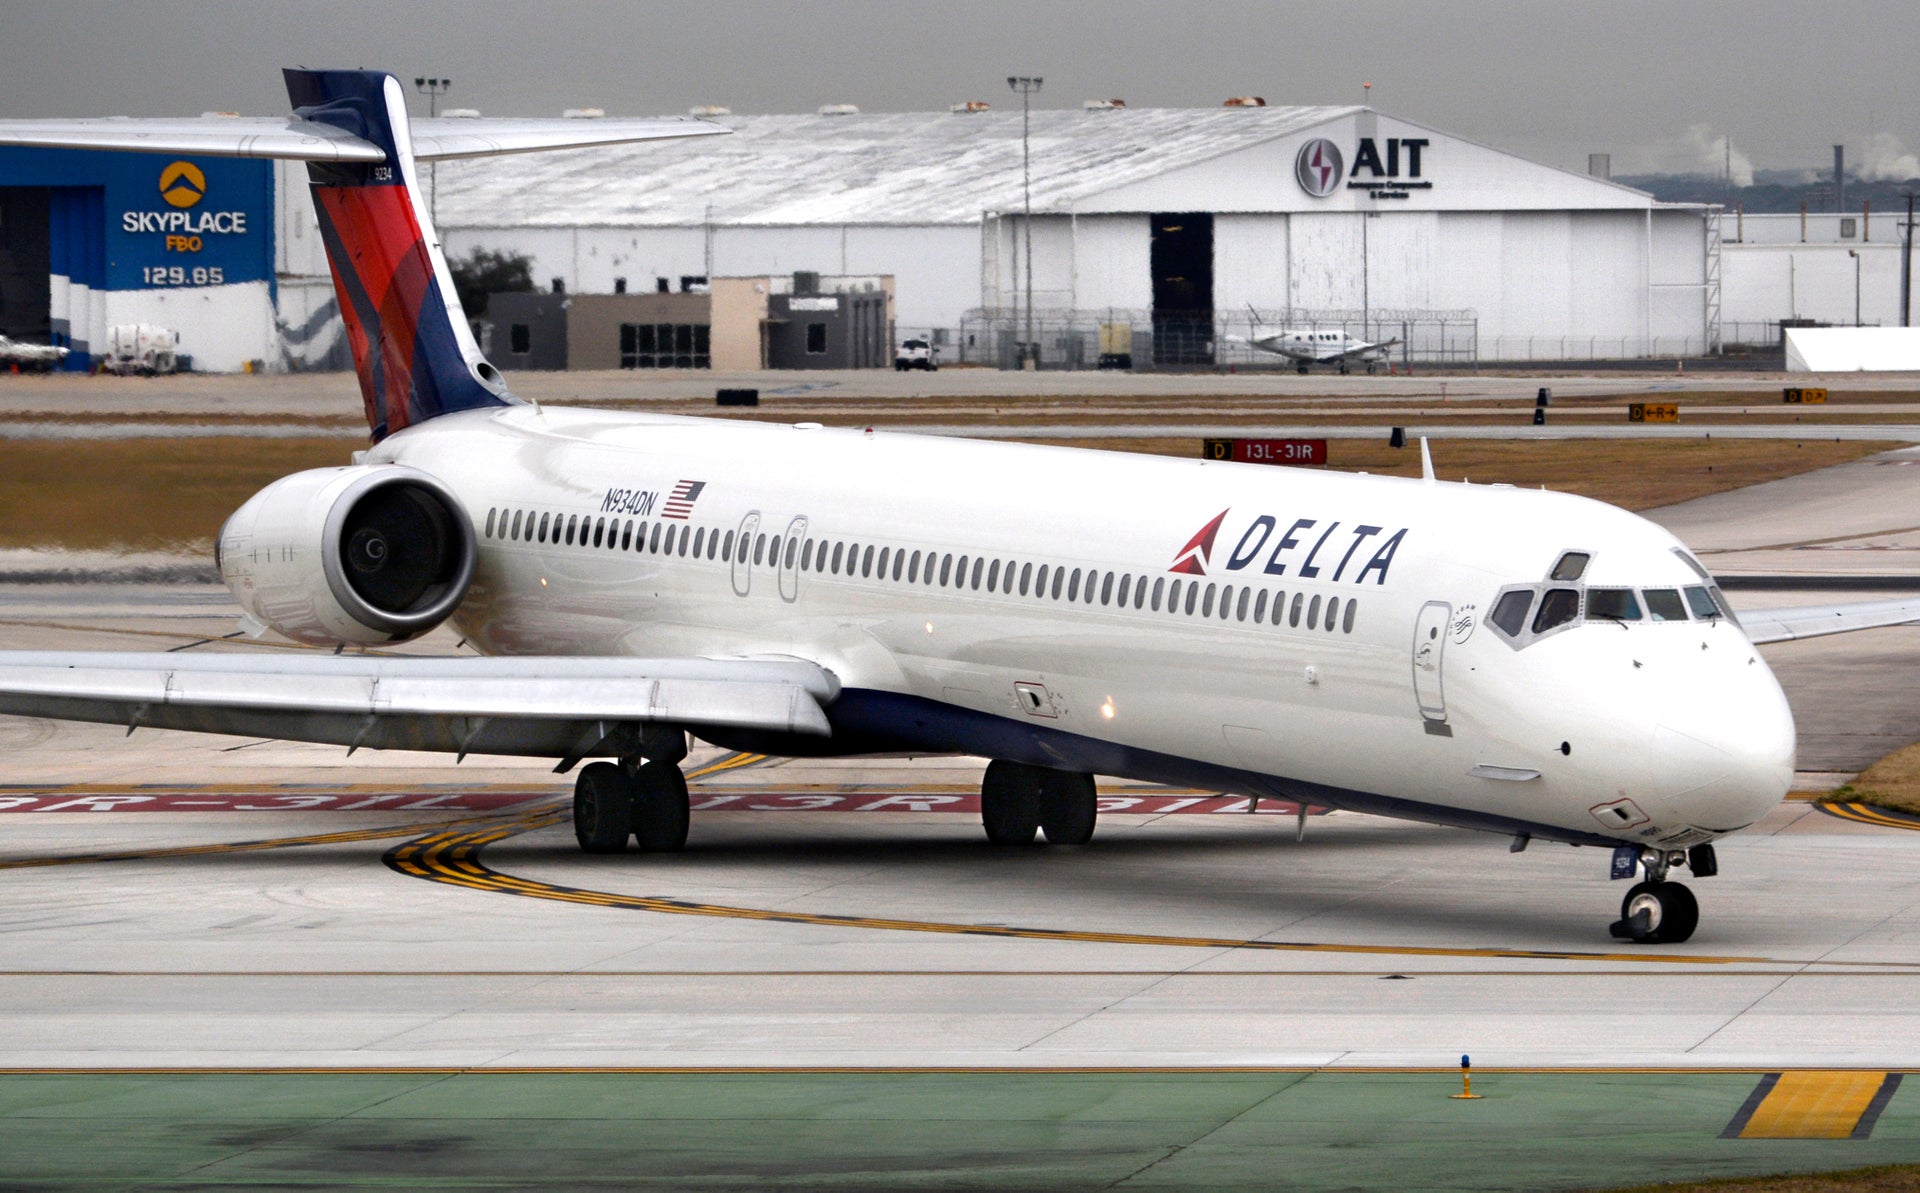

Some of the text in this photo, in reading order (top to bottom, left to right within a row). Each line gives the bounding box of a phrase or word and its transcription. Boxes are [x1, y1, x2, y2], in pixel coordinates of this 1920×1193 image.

[1350, 138, 1429, 177] AIT
[375, 167, 392, 180] 9234
[122, 212, 247, 233] SKYPLACE
[166, 235, 203, 252] FBO
[143, 266, 224, 285] 129.85
[1806, 391, 1813, 401] D
[1633, 406, 1665, 419] D R
[1214, 443, 1313, 459] D 13L-31R
[600, 488, 659, 516] N934DN
[1225, 514, 1409, 586] DELTA
